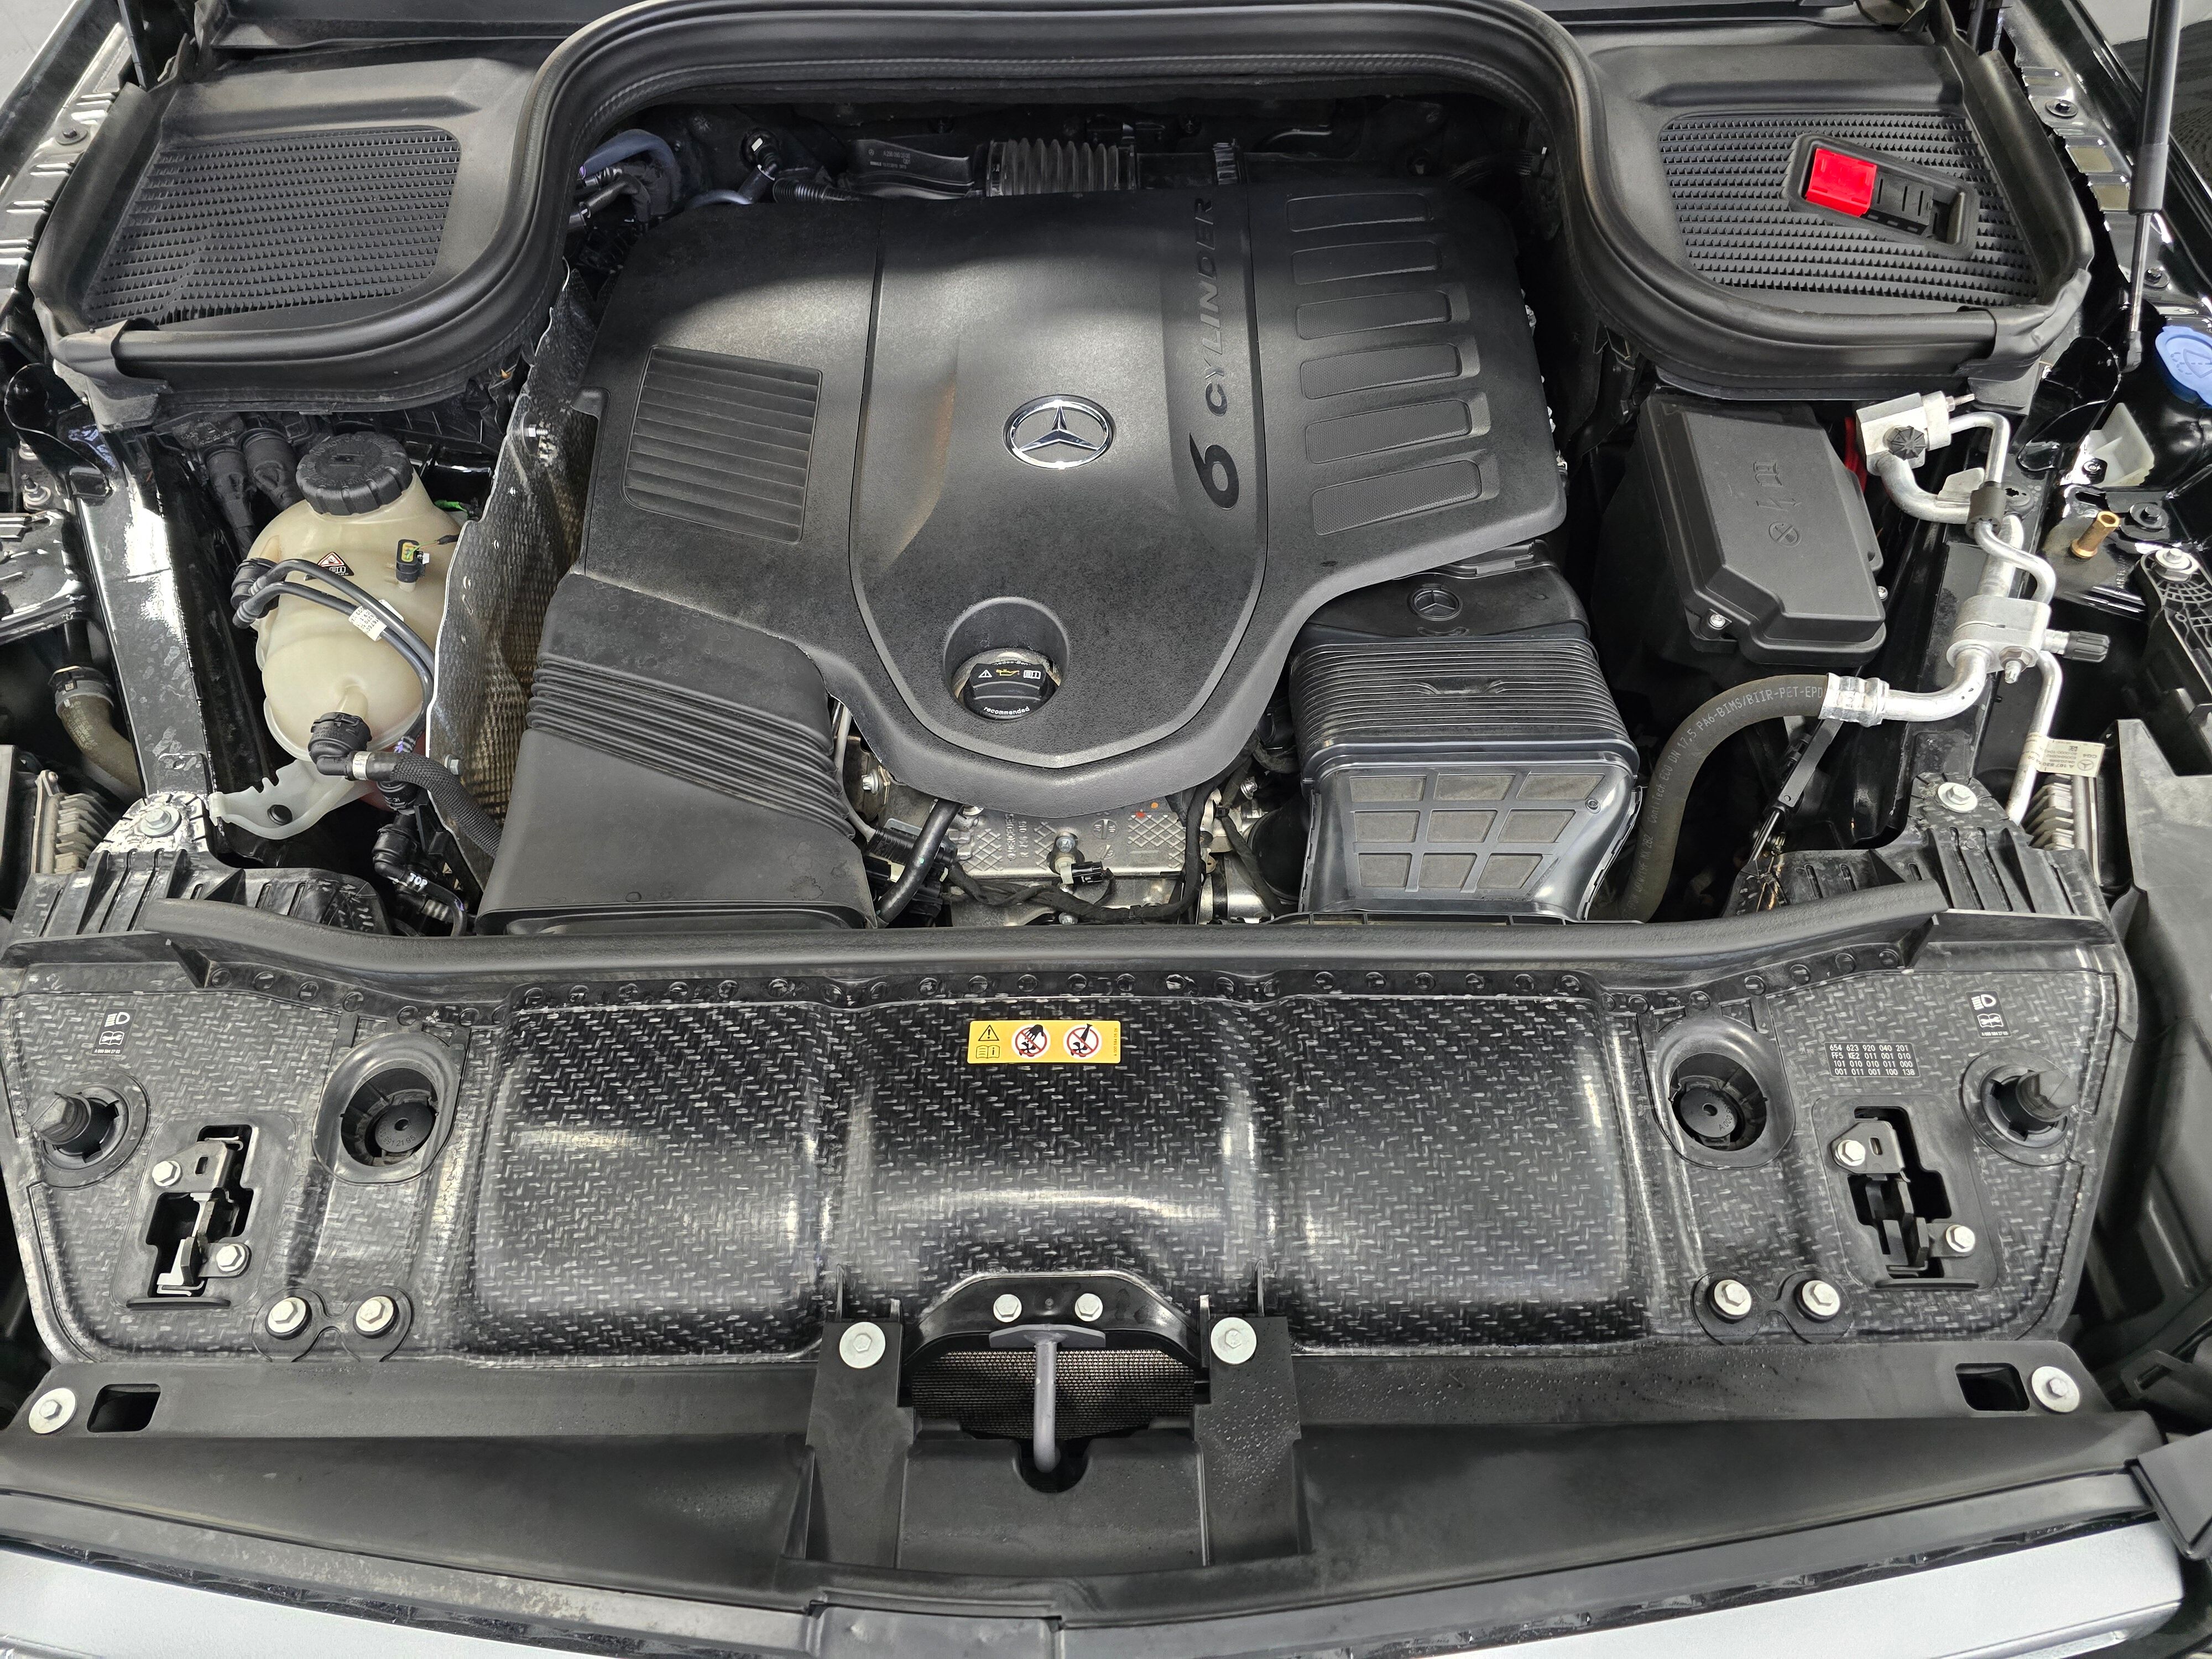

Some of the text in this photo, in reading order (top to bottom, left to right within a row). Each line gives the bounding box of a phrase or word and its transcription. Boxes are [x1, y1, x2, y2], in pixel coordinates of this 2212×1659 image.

[1189, 198, 1239, 510] 6 CYLINDER
[983, 706, 1030, 715] recommended
[1647, 782, 1666, 824] ContiTech
[1660, 764, 1673, 781] ECO
[1667, 750, 1682, 764] DN
[1677, 728, 1697, 749] 17,5
[410, 872, 428, 887] TOP
[1723, 1115, 1733, 1128] 000
[405, 1135, 416, 1144] 95
